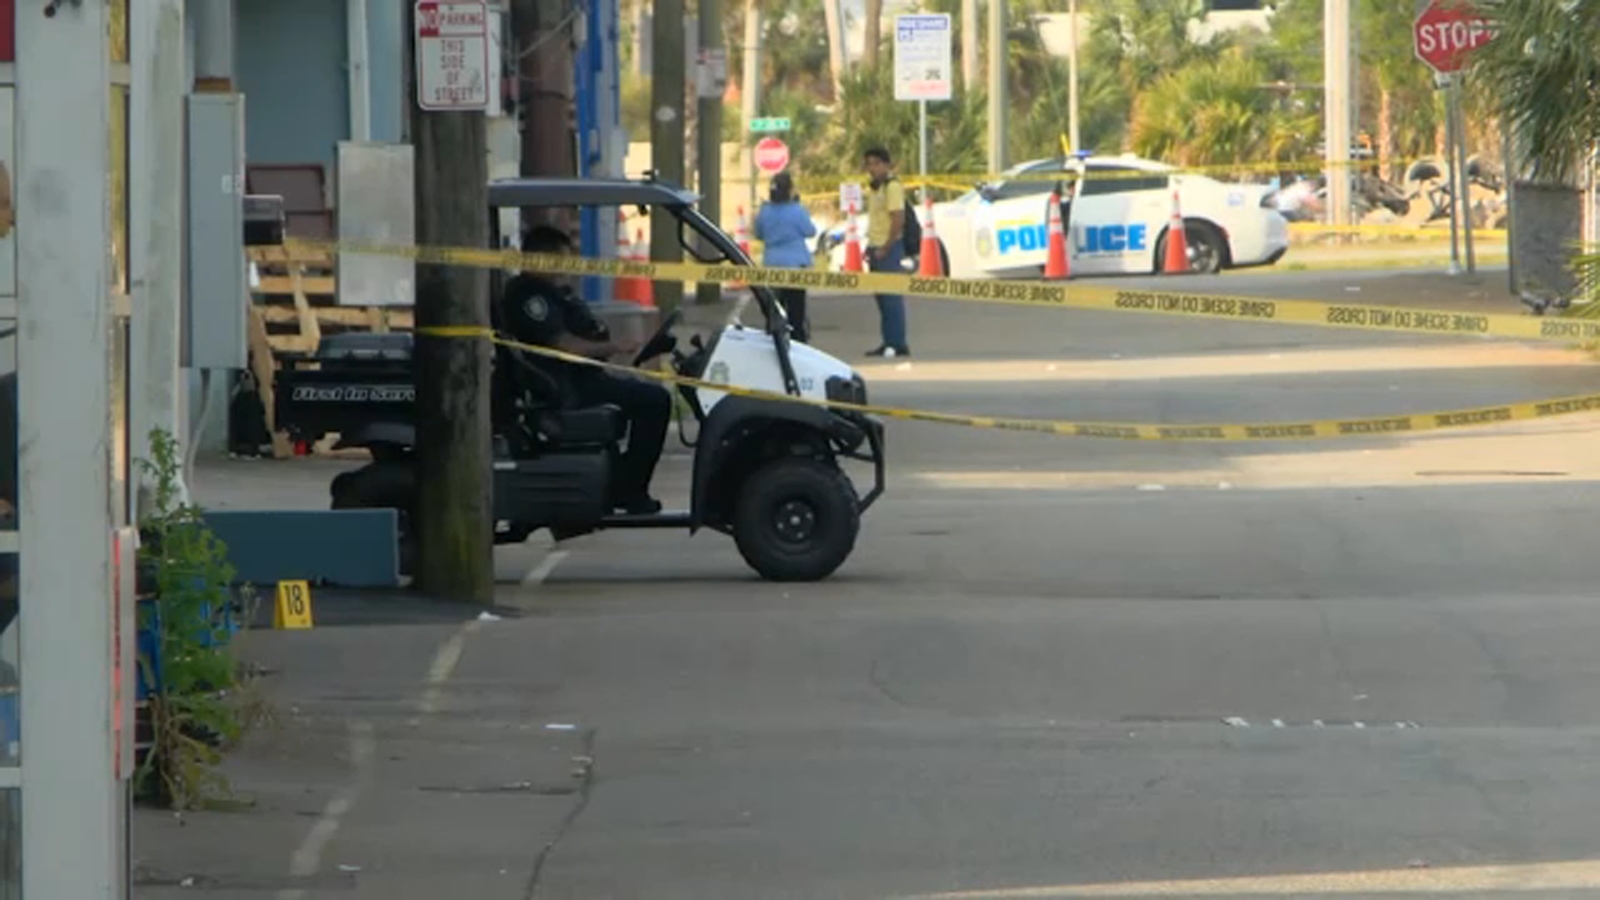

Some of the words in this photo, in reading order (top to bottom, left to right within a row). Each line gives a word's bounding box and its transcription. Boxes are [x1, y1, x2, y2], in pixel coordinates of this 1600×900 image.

[440, 13, 482, 25] PARKING
[1420, 20, 1484, 52] STOP
[441, 39, 465, 53] THIS
[440, 54, 465, 69] SIDE
[445, 70, 460, 85] OF
[435, 86, 474, 101] STREET
[292, 386, 343, 401] First
[284, 584, 305, 616] 18
